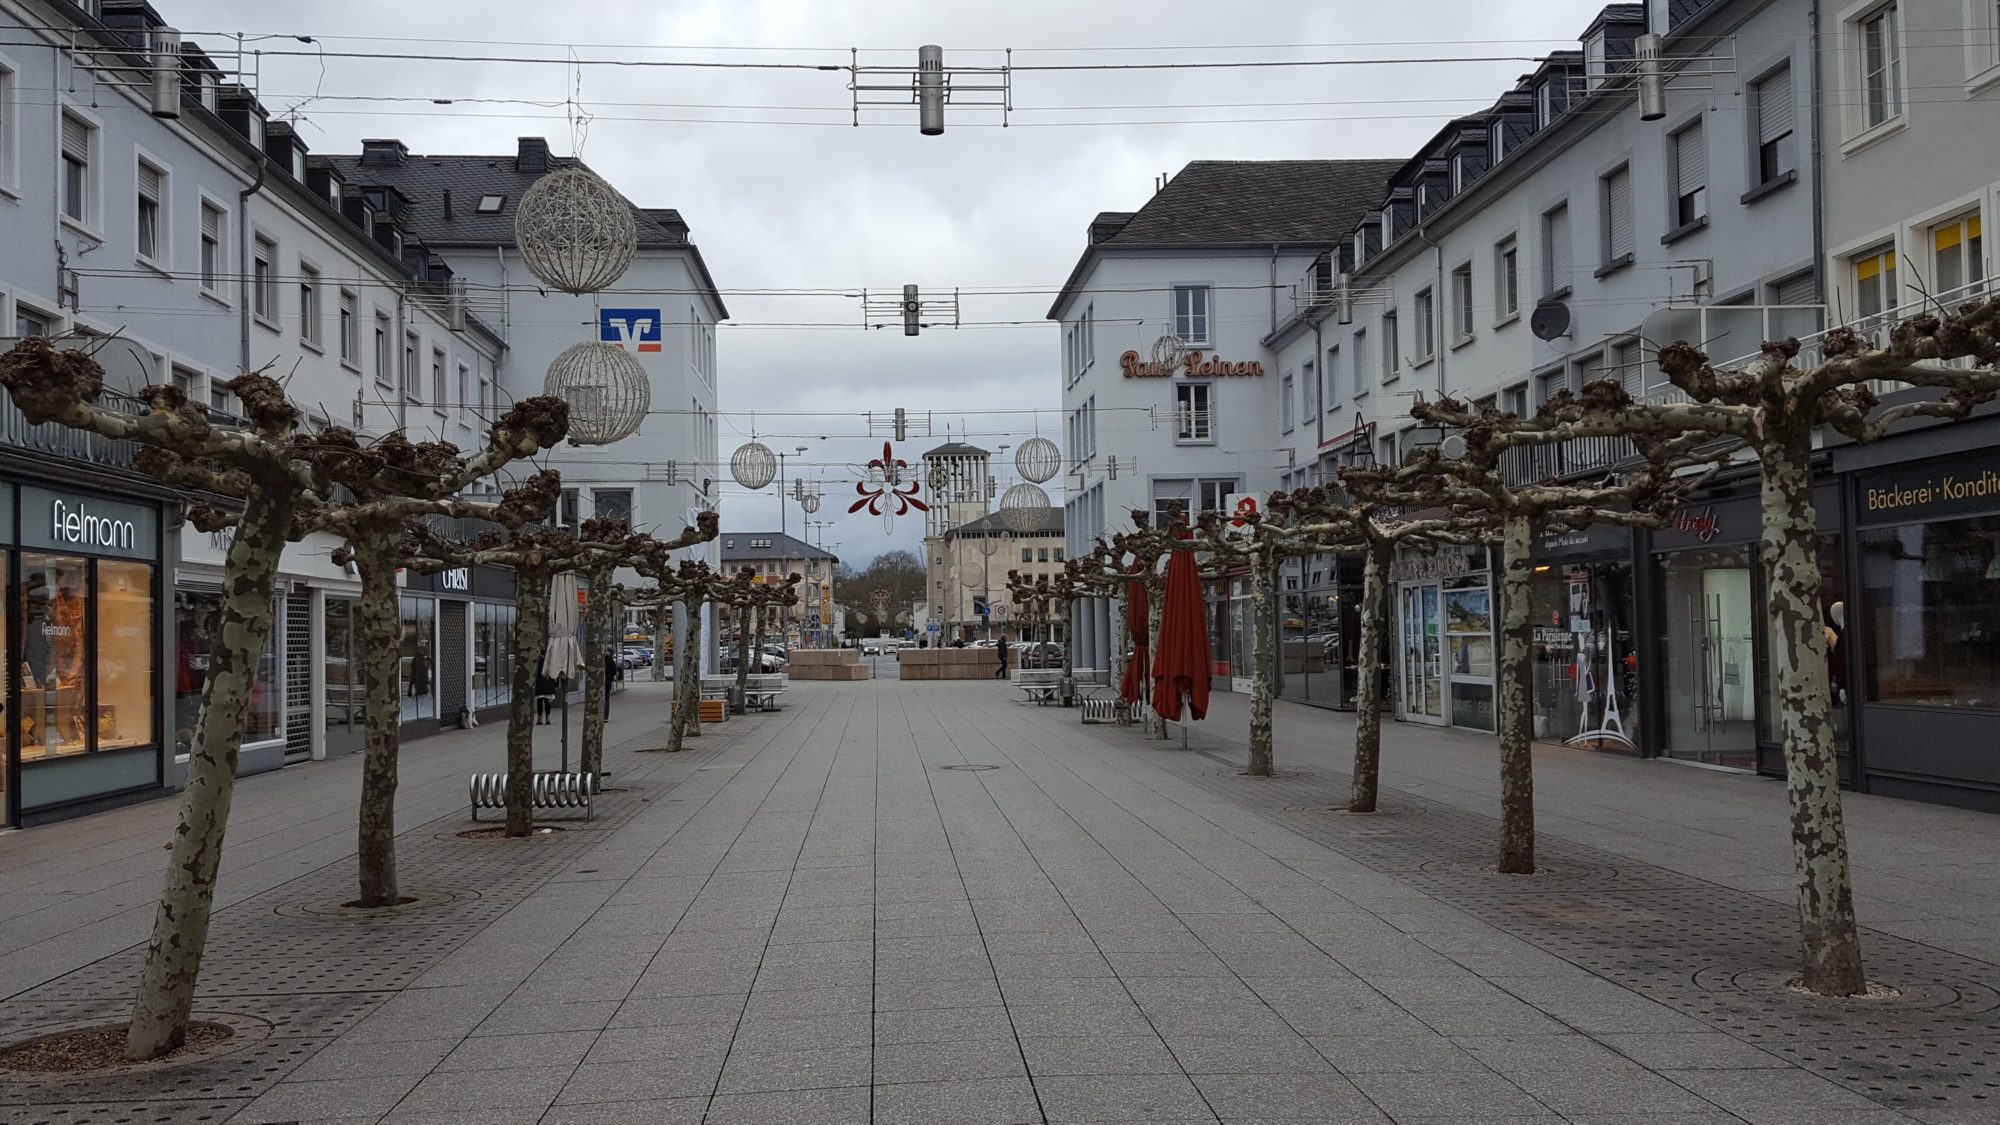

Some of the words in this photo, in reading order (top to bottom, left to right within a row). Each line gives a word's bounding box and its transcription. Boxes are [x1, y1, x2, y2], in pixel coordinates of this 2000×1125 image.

[1183, 350, 1264, 377] Leinen
[1868, 480, 1932, 510] Bäckerei
[54, 499, 134, 549] fielmann
[442, 567, 468, 591] CHRIST
